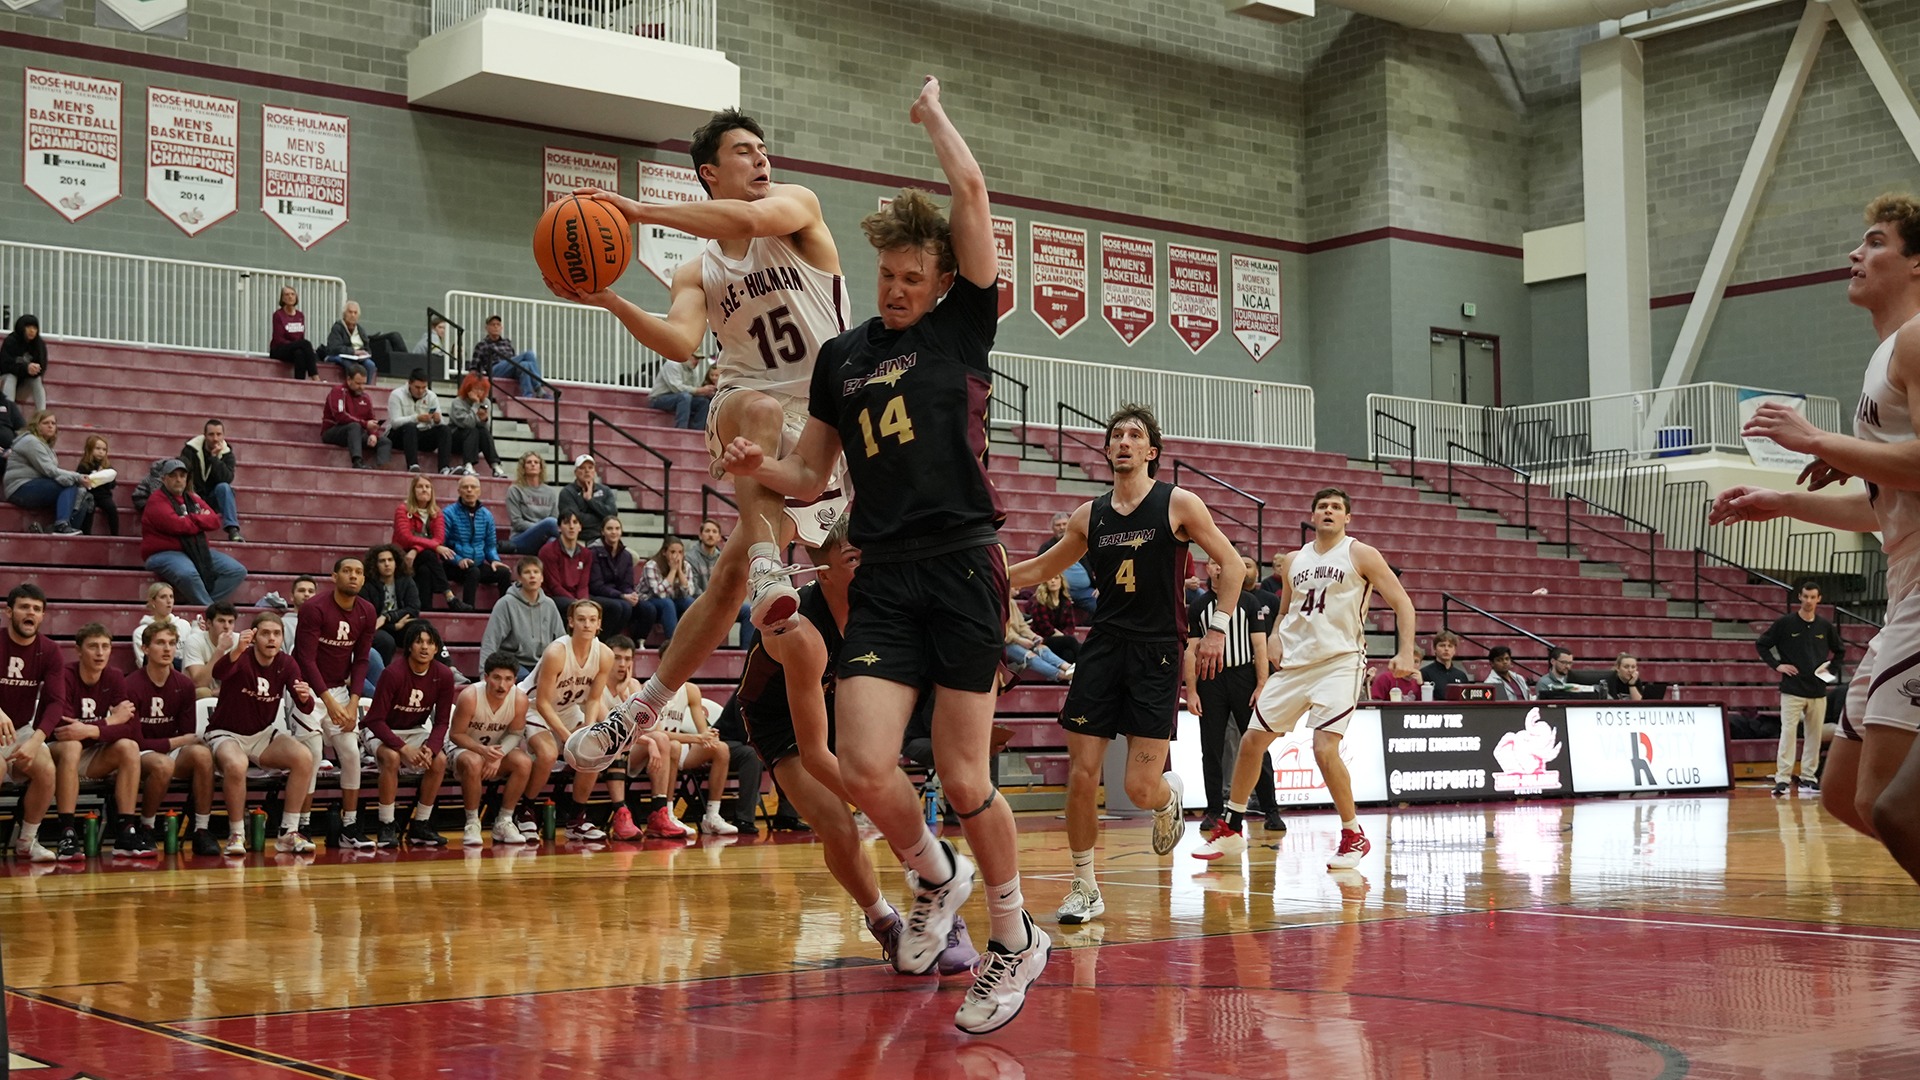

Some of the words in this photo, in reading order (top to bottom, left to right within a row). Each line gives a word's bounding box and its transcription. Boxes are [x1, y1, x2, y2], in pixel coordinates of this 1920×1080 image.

[30, 74, 117, 96] ROSE-HULMAN
[53, 99, 95, 115] MEN'S
[152, 93, 235, 114] ROSE-HULMAN
[30, 108, 117, 130] BASKETBALL
[174, 116, 213, 132] MEN'S
[266, 112, 346, 134] ROSE-HULMAN
[31, 124, 77, 139] REGULAR
[78, 131, 117, 145] SEASON
[150, 125, 235, 147] BASKETBALL
[31, 133, 117, 158] CHAMPIONS
[152, 141, 234, 160] TOURNAMENT
[287, 137, 325, 155] MEN'S
[43, 153, 106, 169] Heartland
[152, 149, 234, 175] CHAMPIONS
[265, 150, 348, 173] BASKETBALL
[546, 153, 617, 171] ROSE-HULMAN
[60, 176, 86, 187] 2014
[164, 169, 223, 184] Heartland
[267, 170, 308, 184] REGULAR
[309, 174, 343, 188] SEASON
[546, 172, 617, 193] VOLLEYBALL
[641, 165, 699, 183] ROSE-HULMA
[180, 191, 205, 201] 2014
[266, 180, 343, 203] CHAMPIONS
[278, 199, 335, 216] Heartland
[652, 228, 698, 241] Heartland
[1033, 227, 1084, 243] ROSE-HULMAN
[563, 218, 589, 285] Wilson
[1040, 244, 1078, 259] WOMEN'S
[1103, 238, 1153, 254] ROSE-HULMAN
[664, 252, 683, 260] 2011
[1033, 252, 1085, 269] BASKETBALL
[1108, 256, 1146, 273] WOMEN'S
[1170, 248, 1217, 264] ROSE-HULMAN
[1035, 265, 1083, 278] TOURNAMENT
[1234, 258, 1278, 273] ROSE-HULMAN
[1035, 272, 1084, 288] CHAMPIONS
[1103, 268, 1154, 286] BASKETBALL
[1174, 266, 1211, 283] WOMEN'S
[1241, 273, 1270, 287] WOMEN'S
[1042, 286, 1079, 299] Heartland
[1105, 284, 1130, 293] REGULAR
[1131, 287, 1151, 297] SEASON
[1170, 278, 1218, 296] BASKETBALL
[1237, 282, 1276, 297] BASKETBALL
[1051, 303, 1068, 311] 2017
[1105, 292, 1152, 308] CHAMPIONS
[1175, 293, 1213, 306] TOURNAMENT
[1242, 293, 1271, 311] NCAA
[1111, 306, 1147, 320] Heartland
[1172, 300, 1217, 319] CHAMPIONS
[1234, 309, 1278, 325] TOURNAMENT
[1178, 315, 1213, 329] Heartland
[1234, 319, 1279, 335] APPEARANCES
[746, 304, 808, 370] 15
[1253, 343, 1261, 356] R
[858, 395, 915, 459] 14
[1098, 528, 1156, 548] EARLHAM
[1115, 559, 1136, 593] 4
[1300, 586, 1328, 617] 44
[336, 620, 350, 641] R
[7, 656, 25, 679] R
[257, 676, 270, 697] R
[151, 696, 165, 717] R
[408, 688, 424, 708] R
[82, 697, 97, 719] R
[1403, 714, 1443, 729] FOLLOW
[1443, 713, 1464, 728] THE
[1595, 710, 1697, 727] ROSE-HULMAN
[1666, 767, 1701, 785] CLUB
